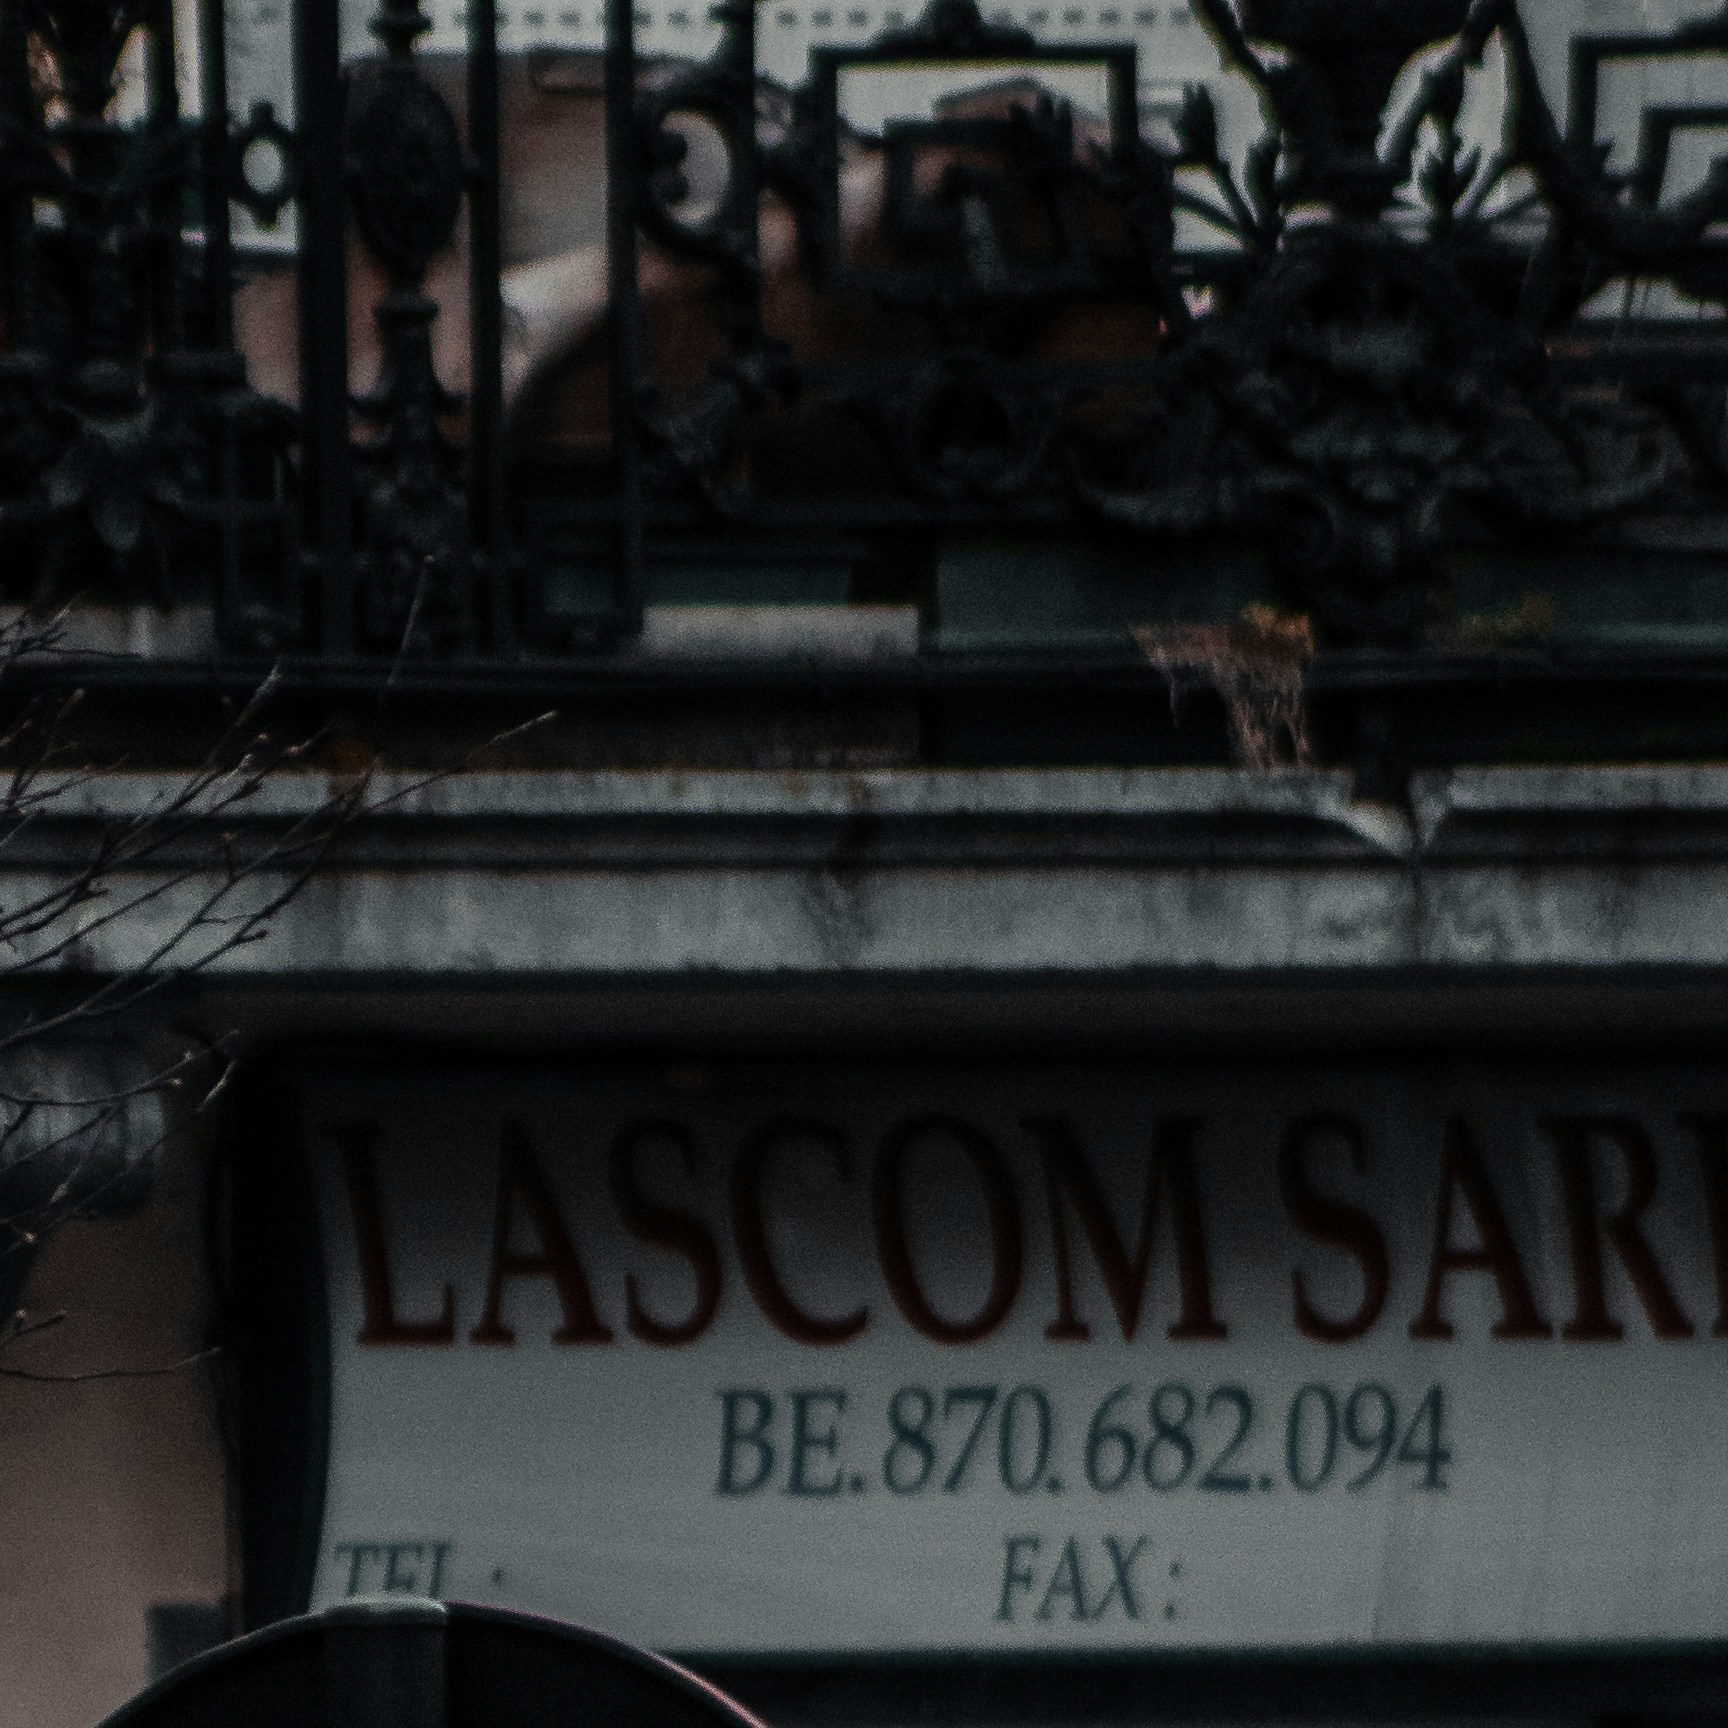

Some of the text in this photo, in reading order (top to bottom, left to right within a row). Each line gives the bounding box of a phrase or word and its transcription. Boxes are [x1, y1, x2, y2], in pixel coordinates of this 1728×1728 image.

[322, 1110, 1728, 1346] LASCOM SAR
[713, 1382, 1455, 1498] BE.870.682.094
